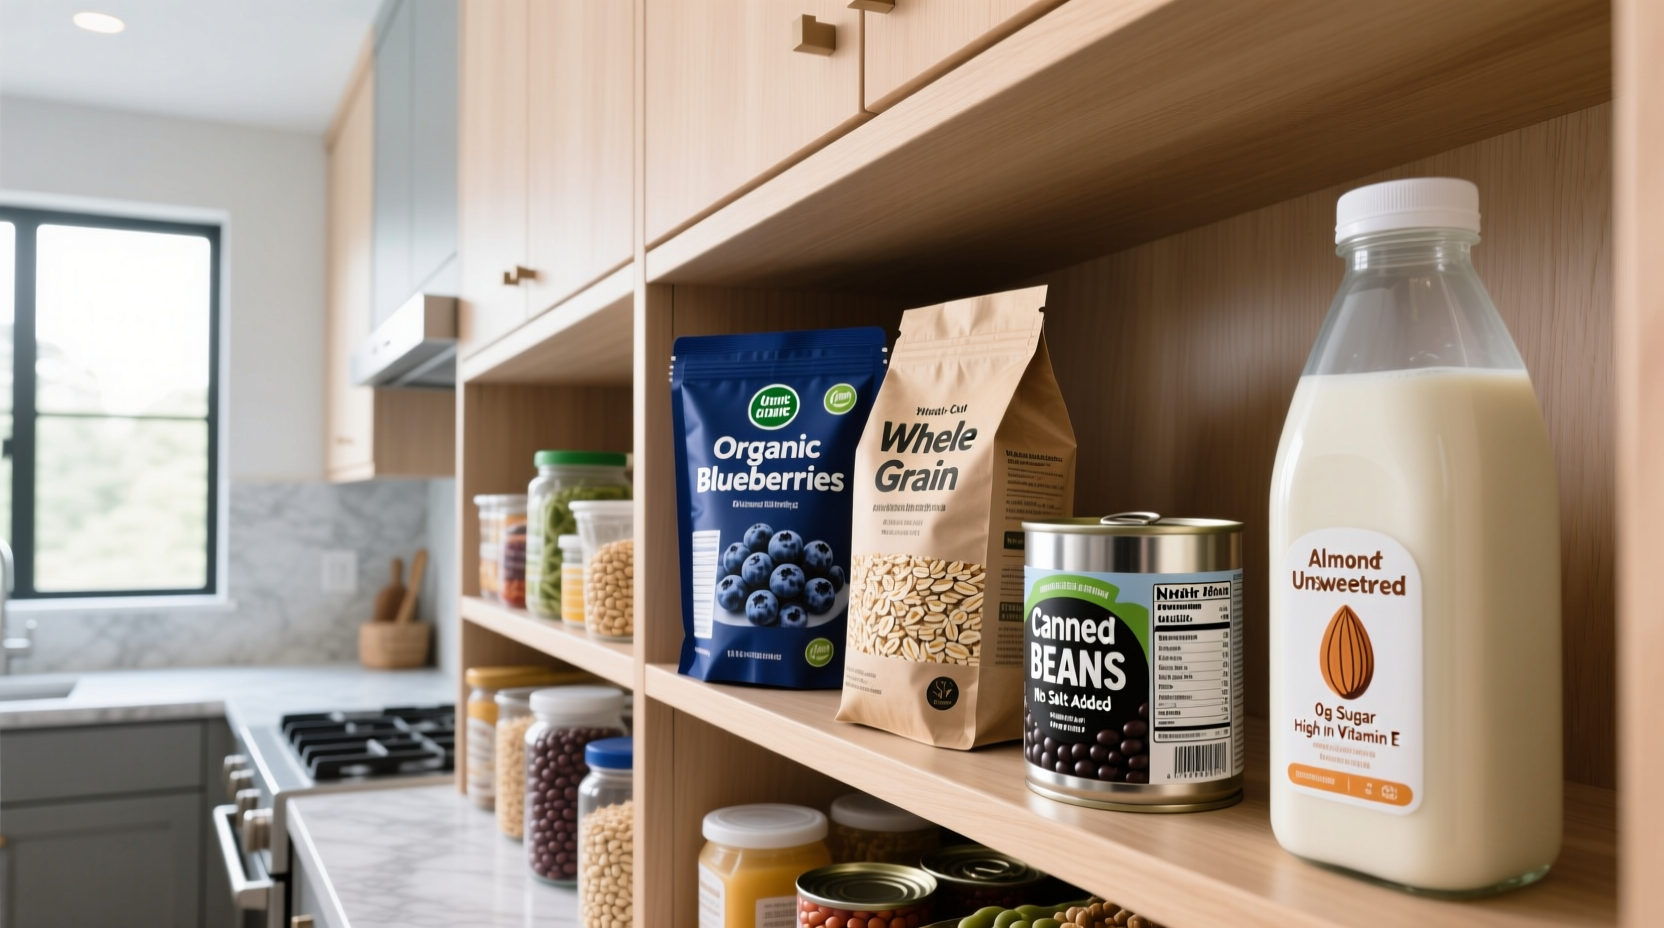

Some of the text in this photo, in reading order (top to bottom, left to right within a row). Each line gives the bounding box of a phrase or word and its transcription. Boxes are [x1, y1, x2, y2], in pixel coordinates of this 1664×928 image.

[713, 434, 821, 466] Organic
[880, 420, 978, 454] Whele
[696, 465, 845, 493] Blueberries
[874, 460, 959, 492] Grain
[1031, 607, 1116, 645] Canned
[1030, 641, 1126, 691] BEANS
[1034, 687, 1112, 712] No Salt Added
[1336, 705, 1376, 726] Sugar
[1294, 718, 1400, 747] High in Vitamin E
